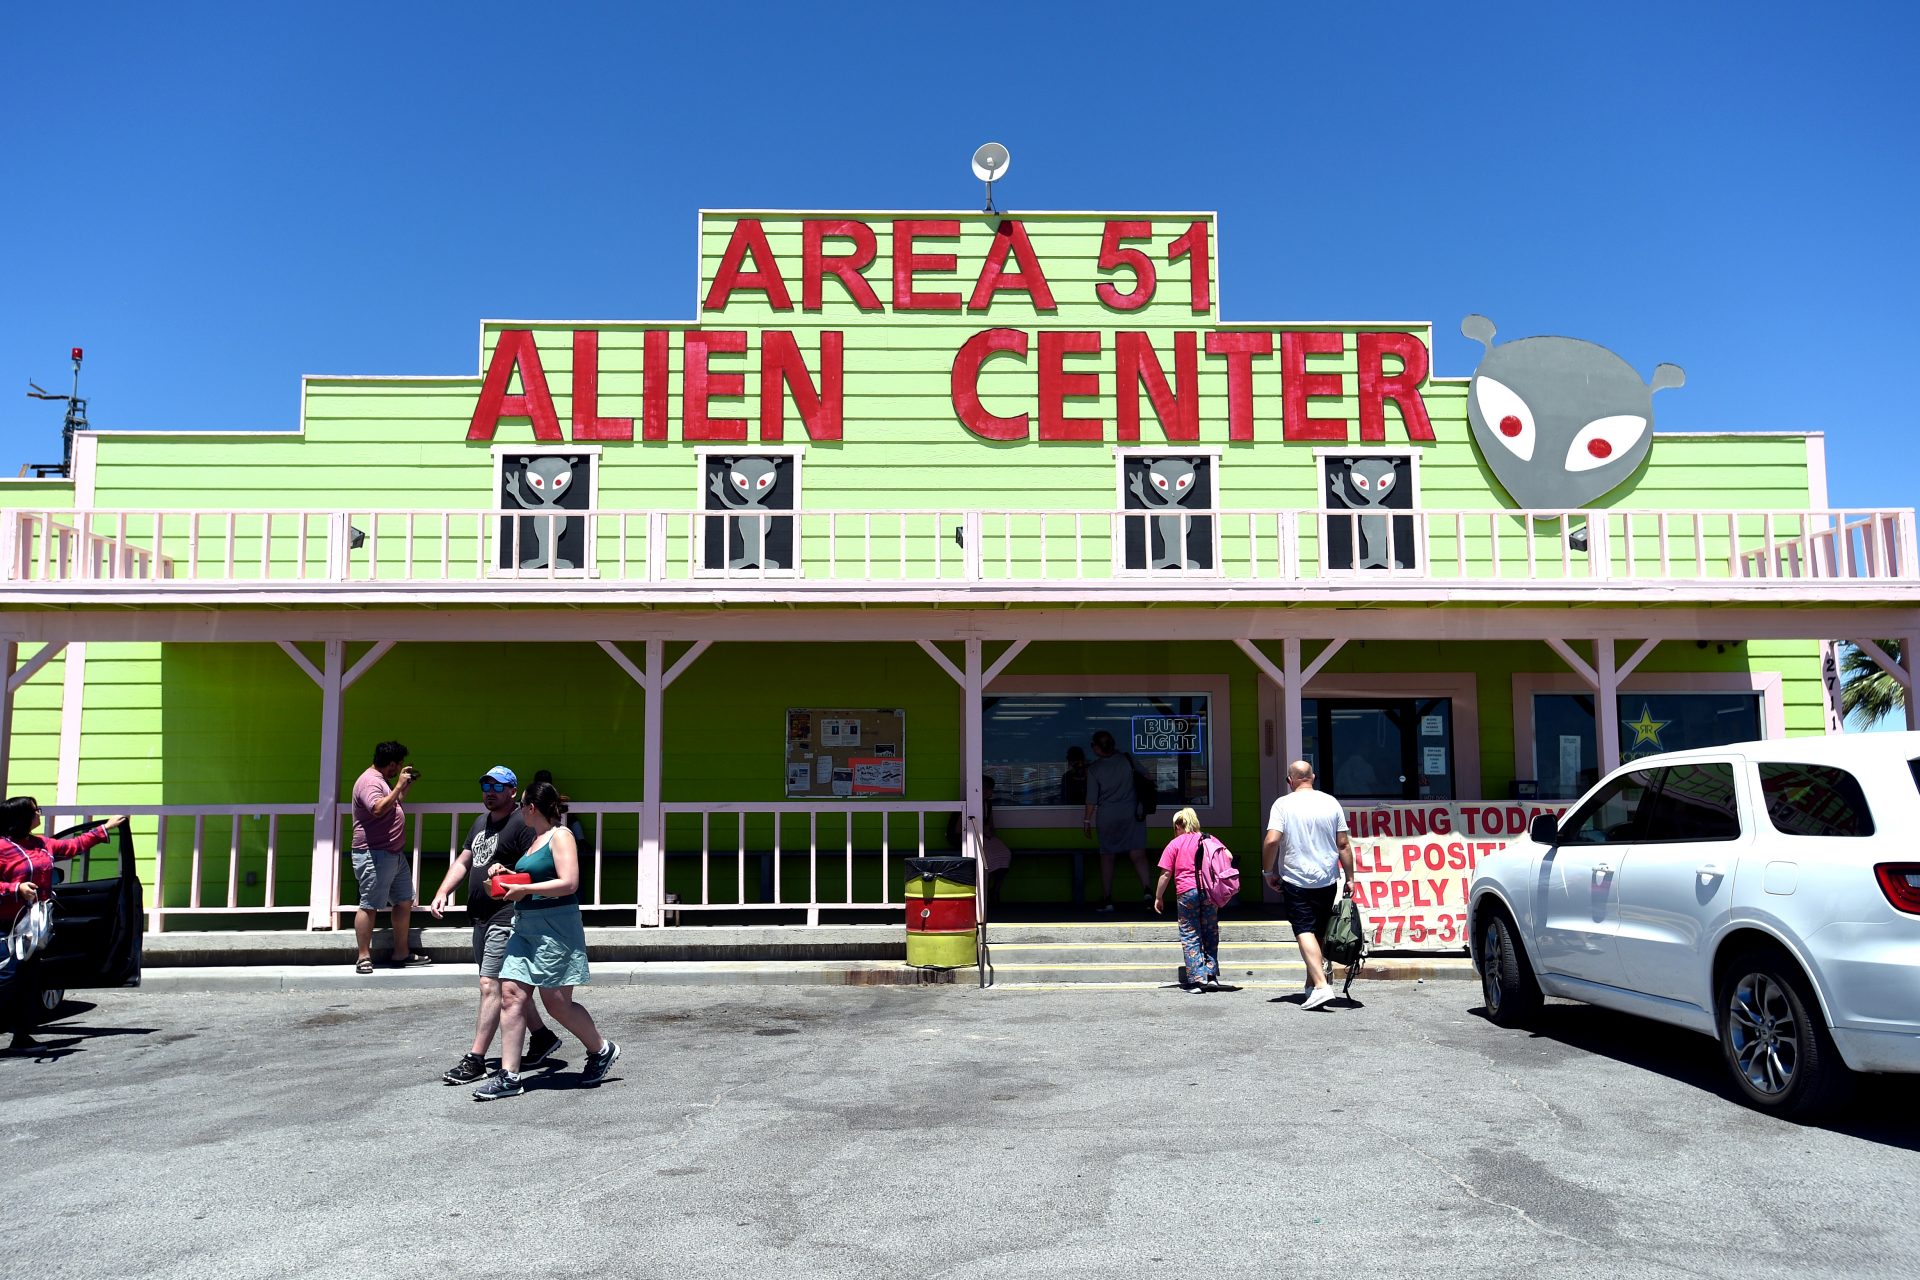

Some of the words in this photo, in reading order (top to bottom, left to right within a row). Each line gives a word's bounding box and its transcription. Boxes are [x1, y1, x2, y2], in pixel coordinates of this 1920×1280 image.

[703, 219, 1057, 312] AREA
[1096, 220, 1211, 312] 51
[466, 329, 844, 442] ALIEN
[951, 327, 1437, 442] CENTER
[1135, 734, 1197, 750] LIGHT
[1144, 718, 1189, 735] BUD
[1338, 845, 1393, 873] LL
[1402, 842, 1506, 872] POSIT
[1352, 878, 1449, 909] APPLY
